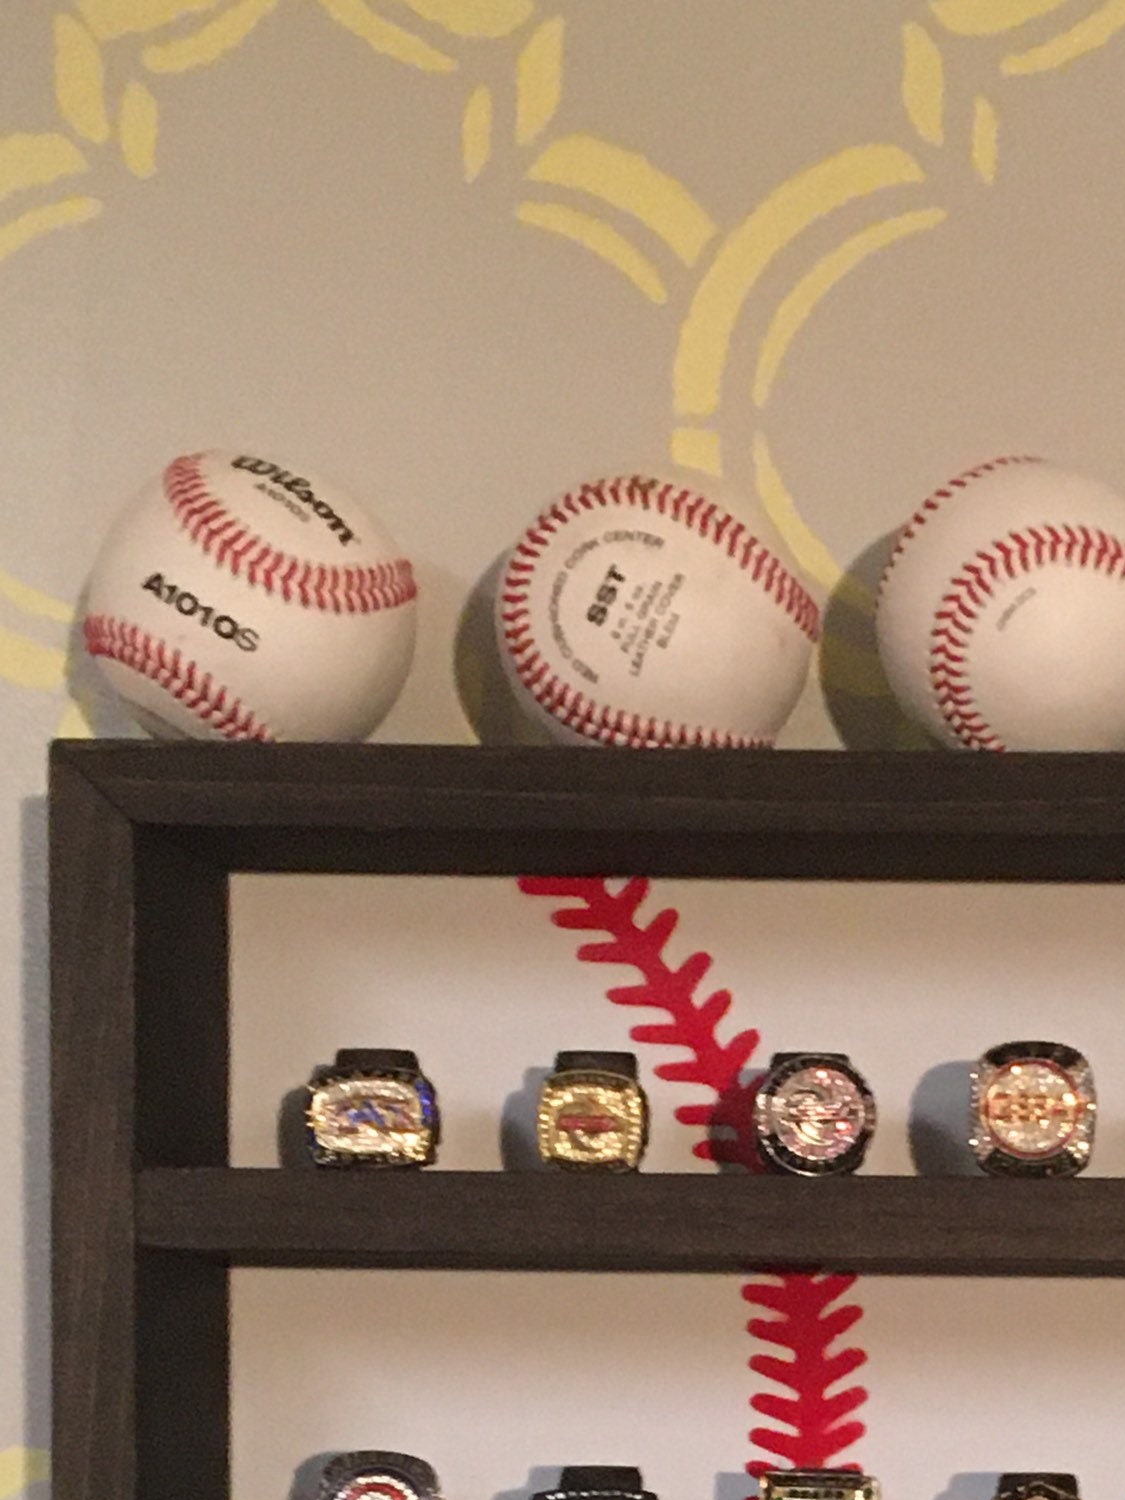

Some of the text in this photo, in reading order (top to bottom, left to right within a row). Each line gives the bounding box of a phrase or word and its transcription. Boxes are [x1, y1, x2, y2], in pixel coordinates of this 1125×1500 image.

[231, 455, 356, 547] Wilson
[141, 571, 260, 653] A1010S
[587, 564, 626, 627] SST
